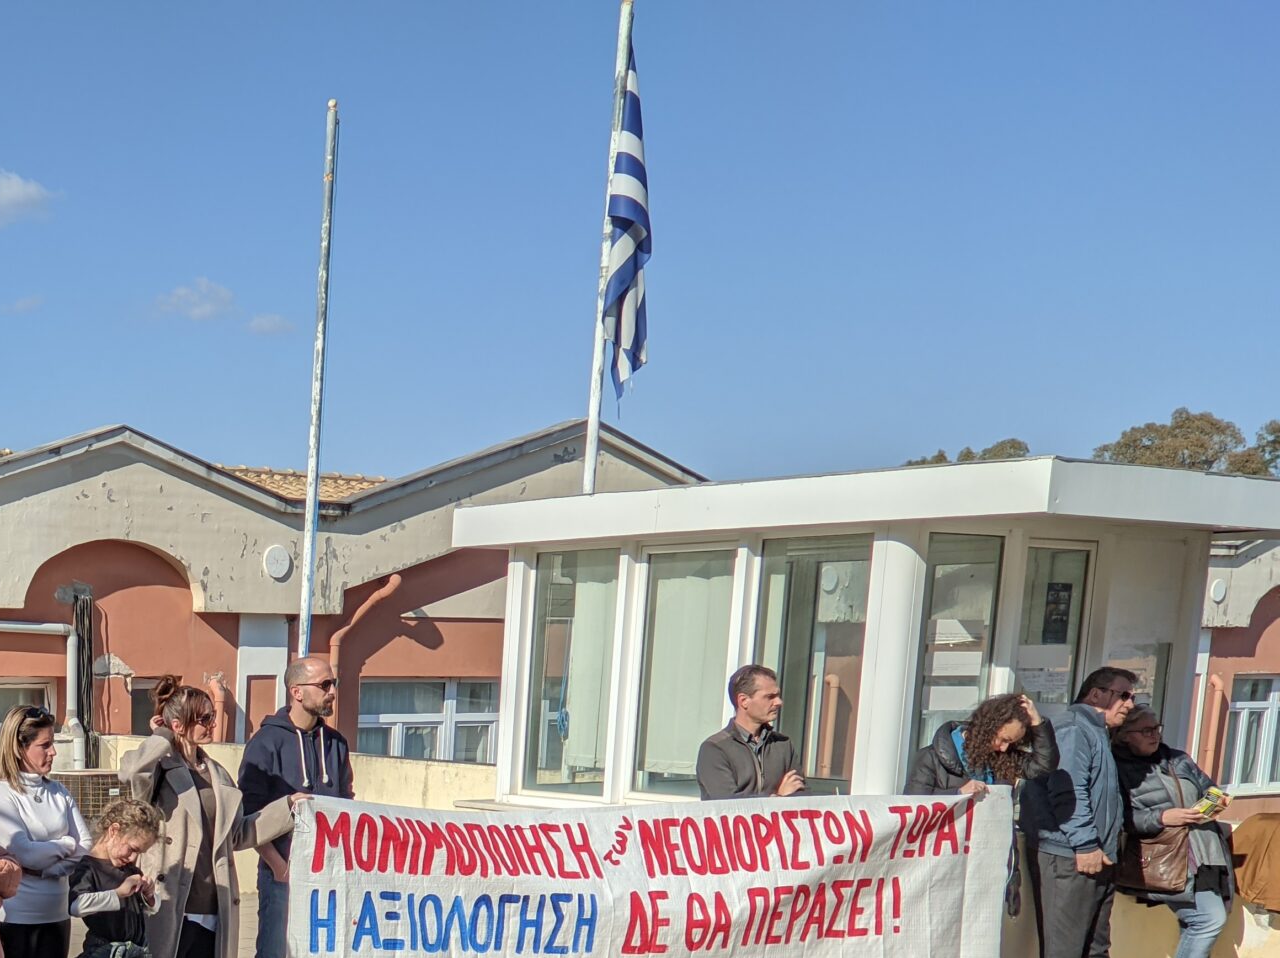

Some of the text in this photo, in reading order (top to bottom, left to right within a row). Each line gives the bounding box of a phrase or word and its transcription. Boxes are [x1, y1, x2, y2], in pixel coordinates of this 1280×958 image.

[311, 810, 604, 880] ΜΟΝΙΜΟΠΟΙΗΣΗ
[603, 815, 634, 867] των
[309, 876, 901, 955] Η ΑΞΙΟΛΟΓΗΣΗ ΔΕ ΘΑ ΠΕΡΑΣΕΙ!
